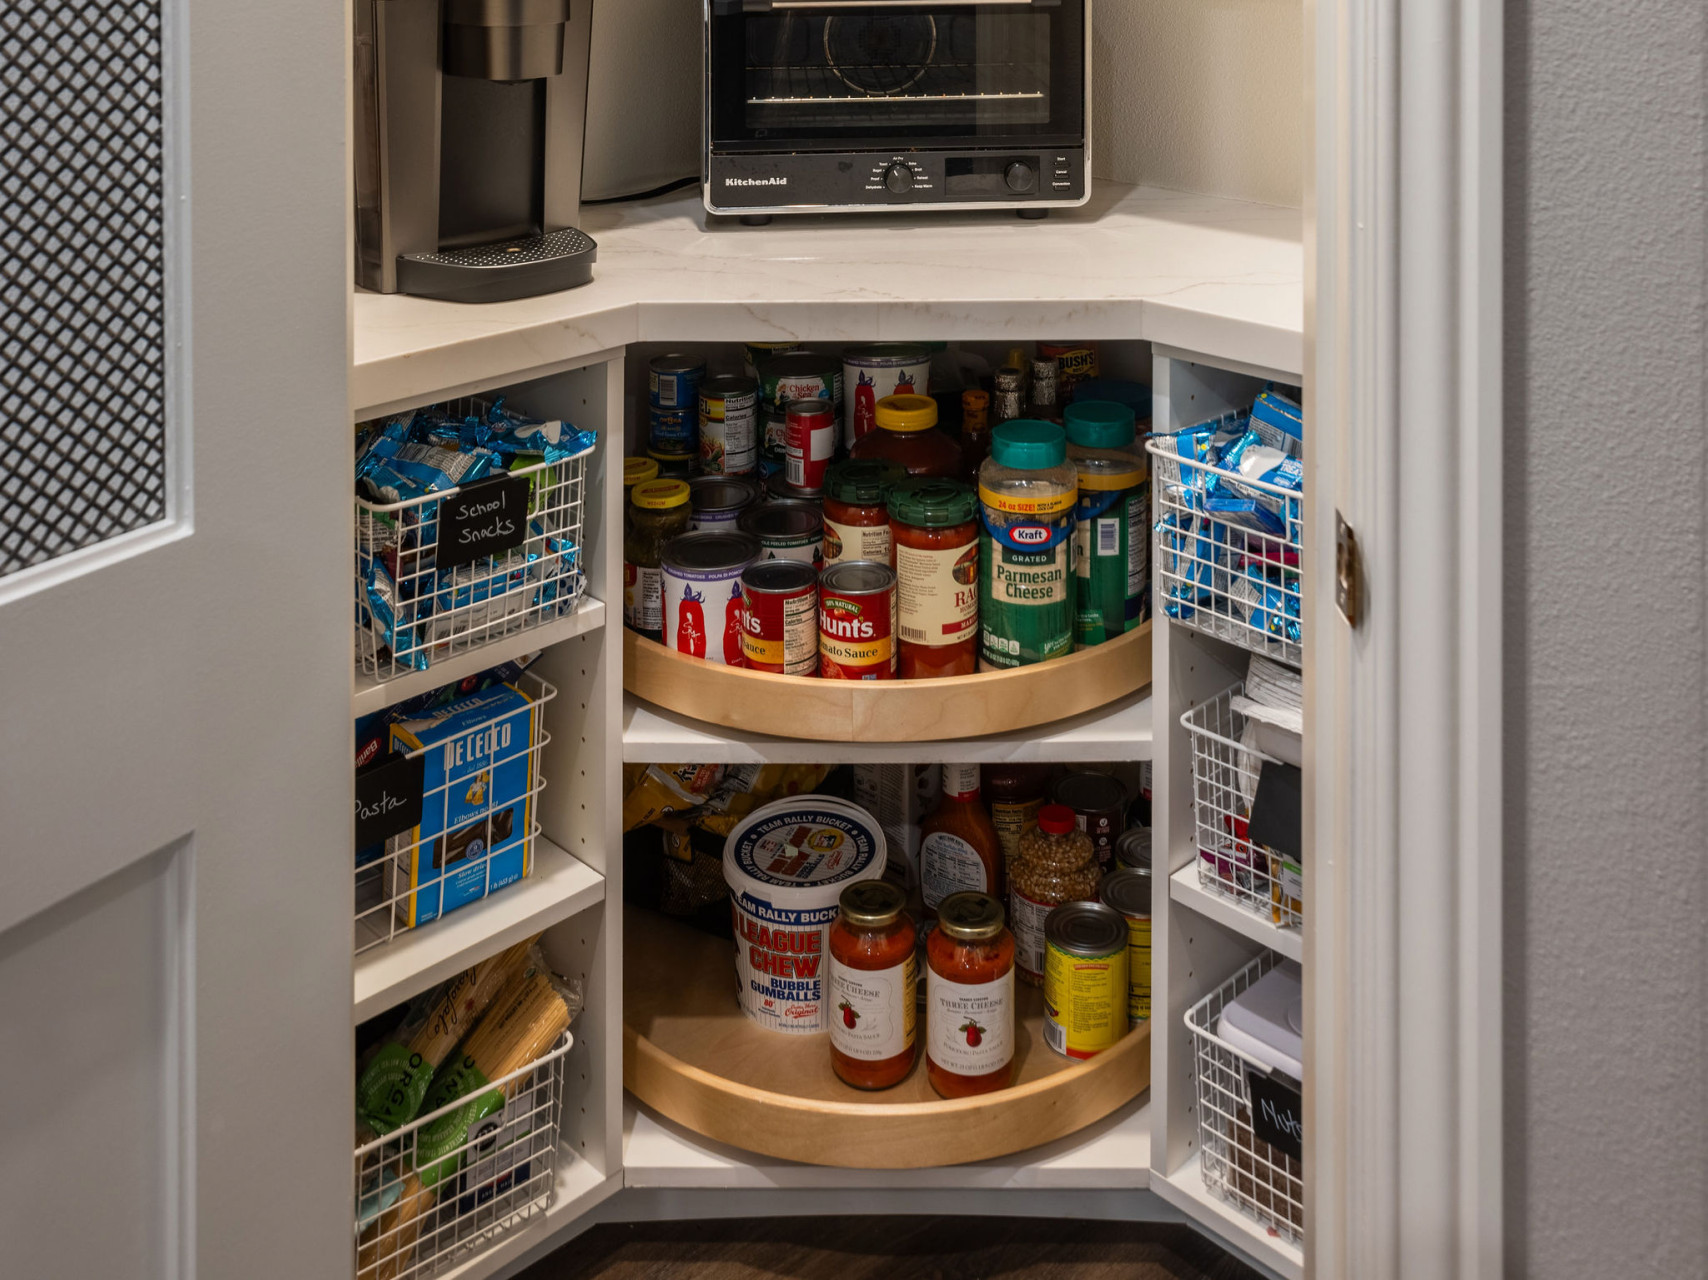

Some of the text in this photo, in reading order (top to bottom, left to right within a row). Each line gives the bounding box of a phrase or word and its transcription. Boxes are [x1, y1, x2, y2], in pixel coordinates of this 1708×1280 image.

[725, 177, 787, 186] KitchenAid
[1059, 351, 1094, 369] BUSH'S
[789, 384, 820, 393] Chicken
[797, 391, 812, 400] Sea
[456, 490, 506, 520] School
[999, 501, 1006, 509] 24
[1018, 503, 1035, 511] SIZE!
[459, 516, 516, 544] Snacks
[1018, 530, 1043, 539] Kraft
[1012, 554, 1047, 562] GRATED
[997, 565, 1062, 584] Parmesan
[1006, 582, 1053, 599] Cheese
[844, 648, 878, 658] Sauce
[466, 723, 511, 762] CECCO
[454, 808, 478, 824] Elbows
[757, 815, 852, 834] TEAM RALLY BUCKET
[855, 834, 869, 852] TEAM
[758, 907, 798, 923] RALLY
[801, 908, 837, 923] BUCK
[740, 912, 822, 955] LEAGUE
[749, 945, 822, 979] CHEW
[751, 980, 821, 1001] GUMBALLS
[771, 978, 821, 991] BUBBLE
[846, 983, 880, 998] CHEESE
[940, 998, 1002, 1010] THREE CHEESE
[784, 1006, 819, 1019] Original
